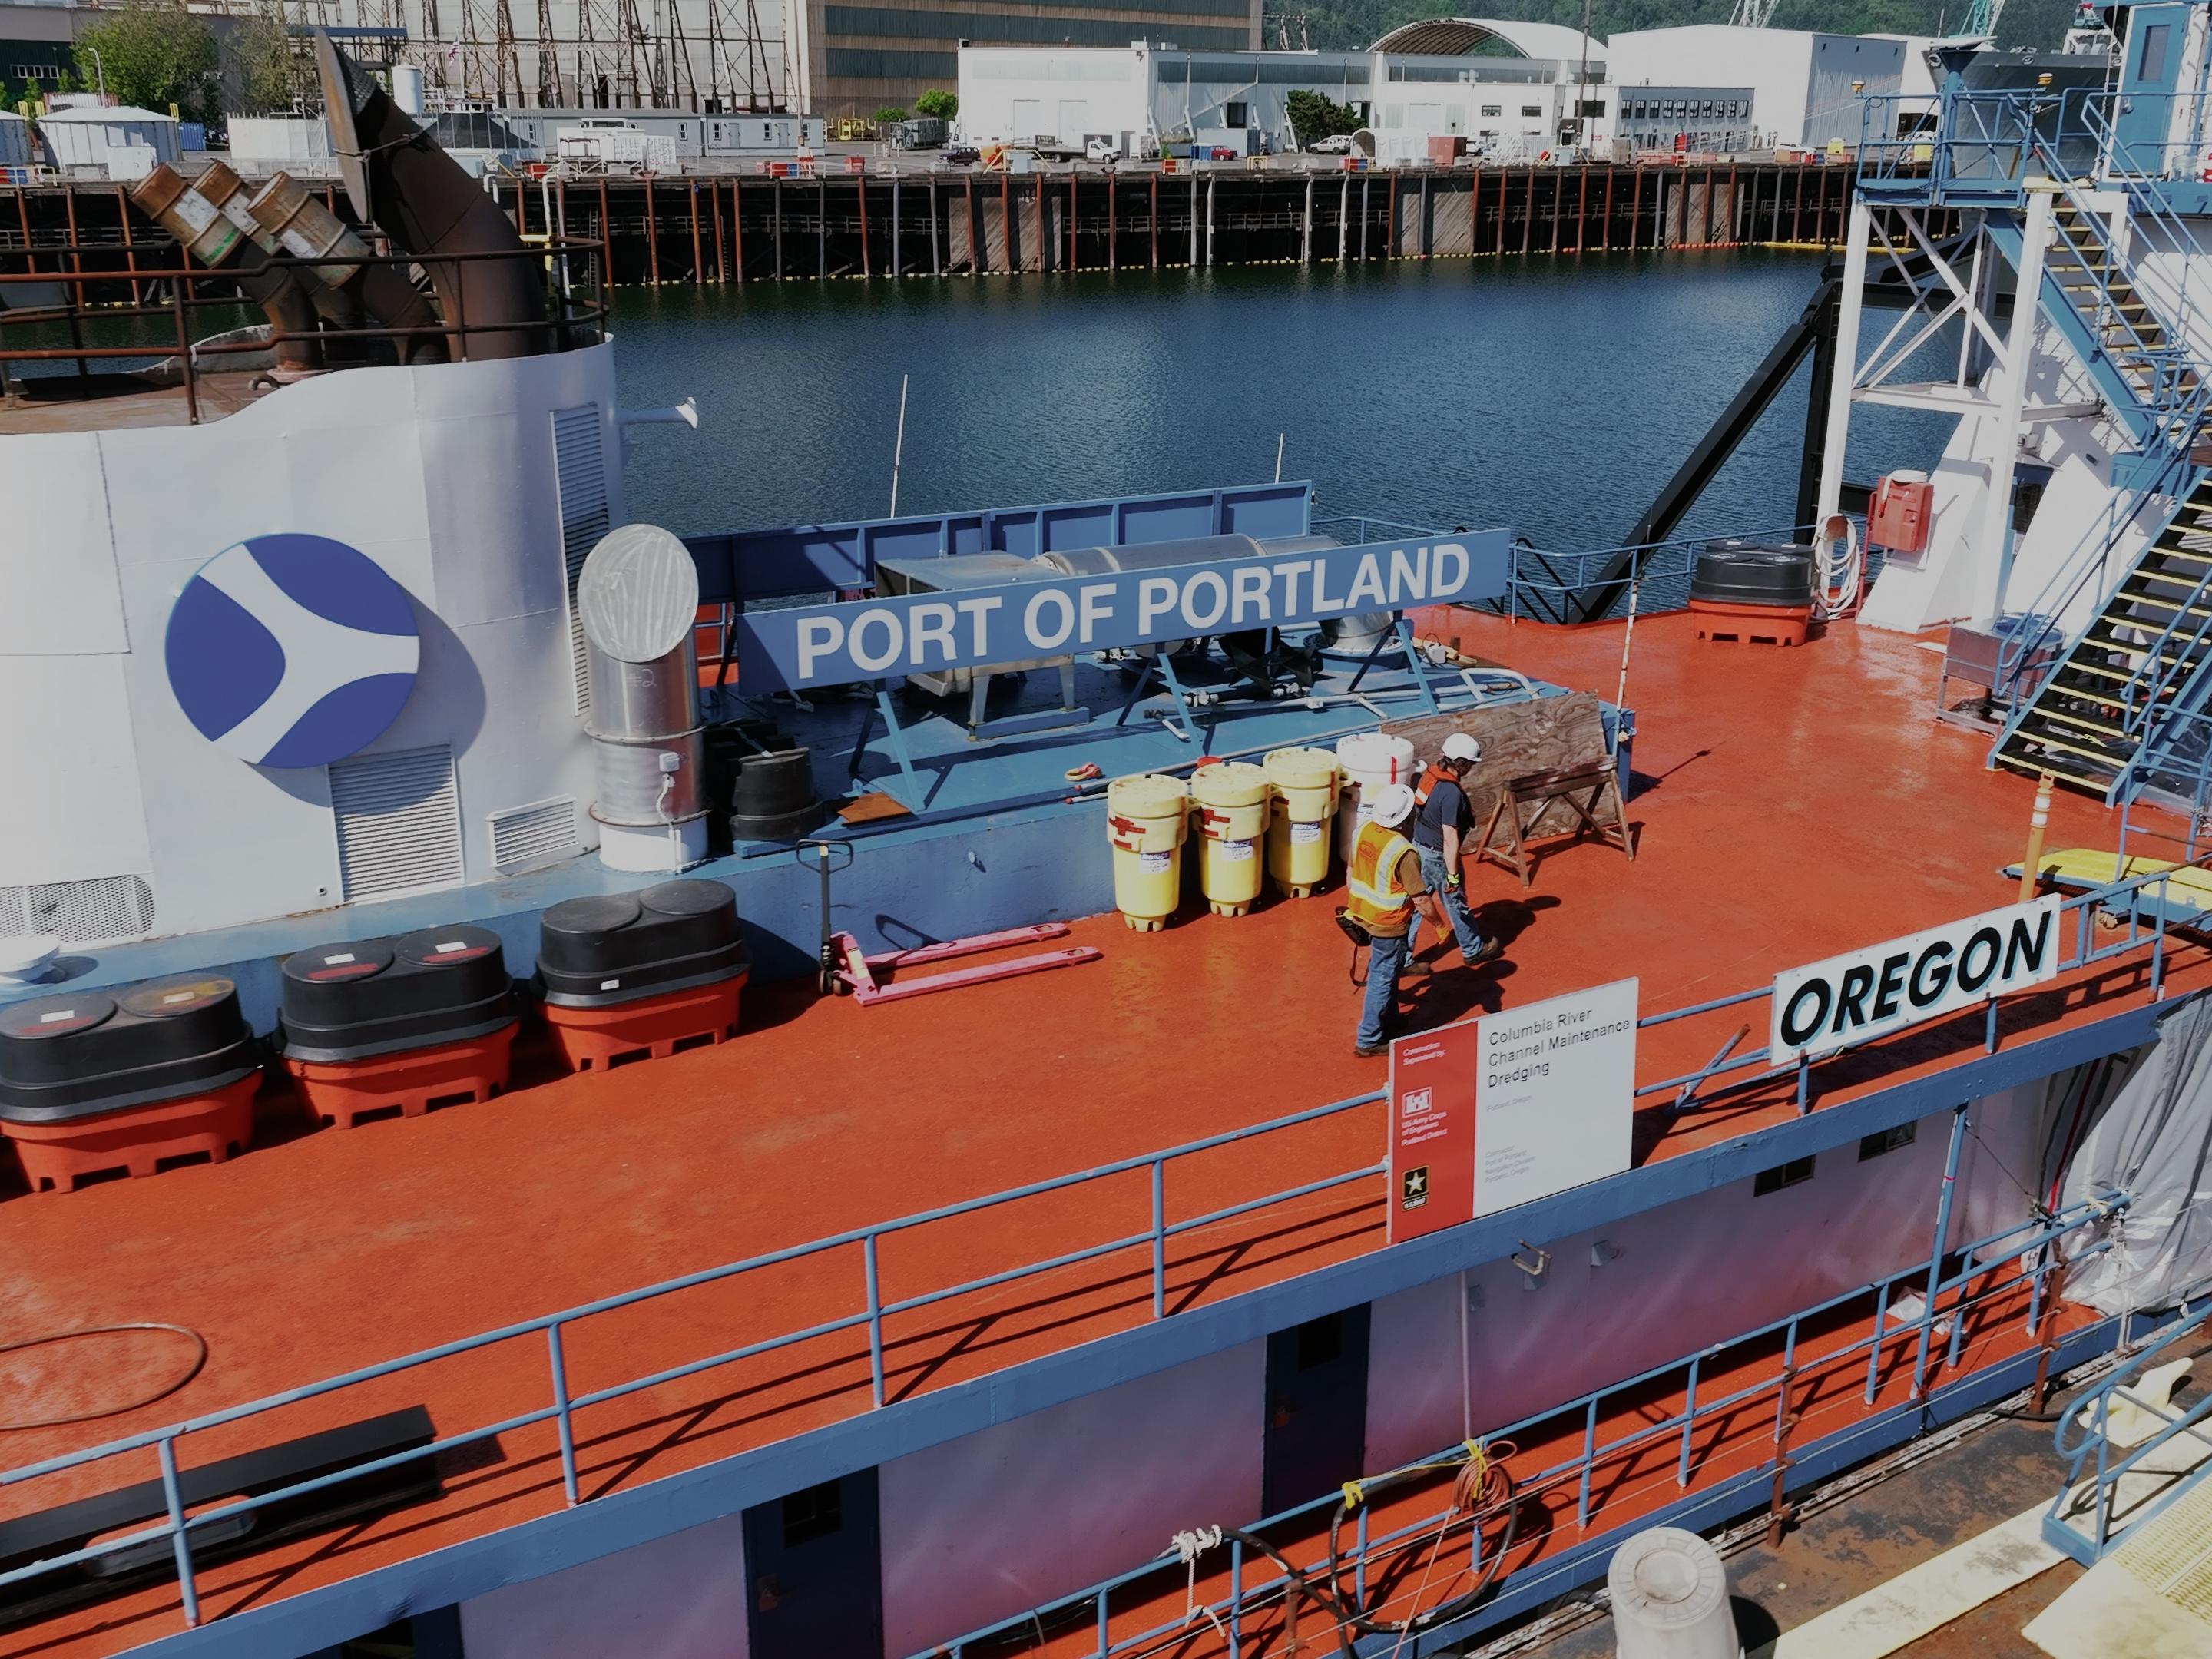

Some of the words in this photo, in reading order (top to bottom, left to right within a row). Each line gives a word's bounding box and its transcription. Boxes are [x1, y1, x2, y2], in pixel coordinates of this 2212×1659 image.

[796, 595, 1002, 680] PORT
[1023, 582, 1118, 650] OF
[1137, 542, 1470, 636] PORTLAND
[1780, 910, 2051, 1046] OREGON
[1488, 1039, 1545, 1066] Channel
[1548, 1019, 1631, 1051] Maintenance
[1489, 1018, 1553, 1045] Columbia
[1557, 1008, 1593, 1028] River
[1488, 1062, 1550, 1088] Dredging
